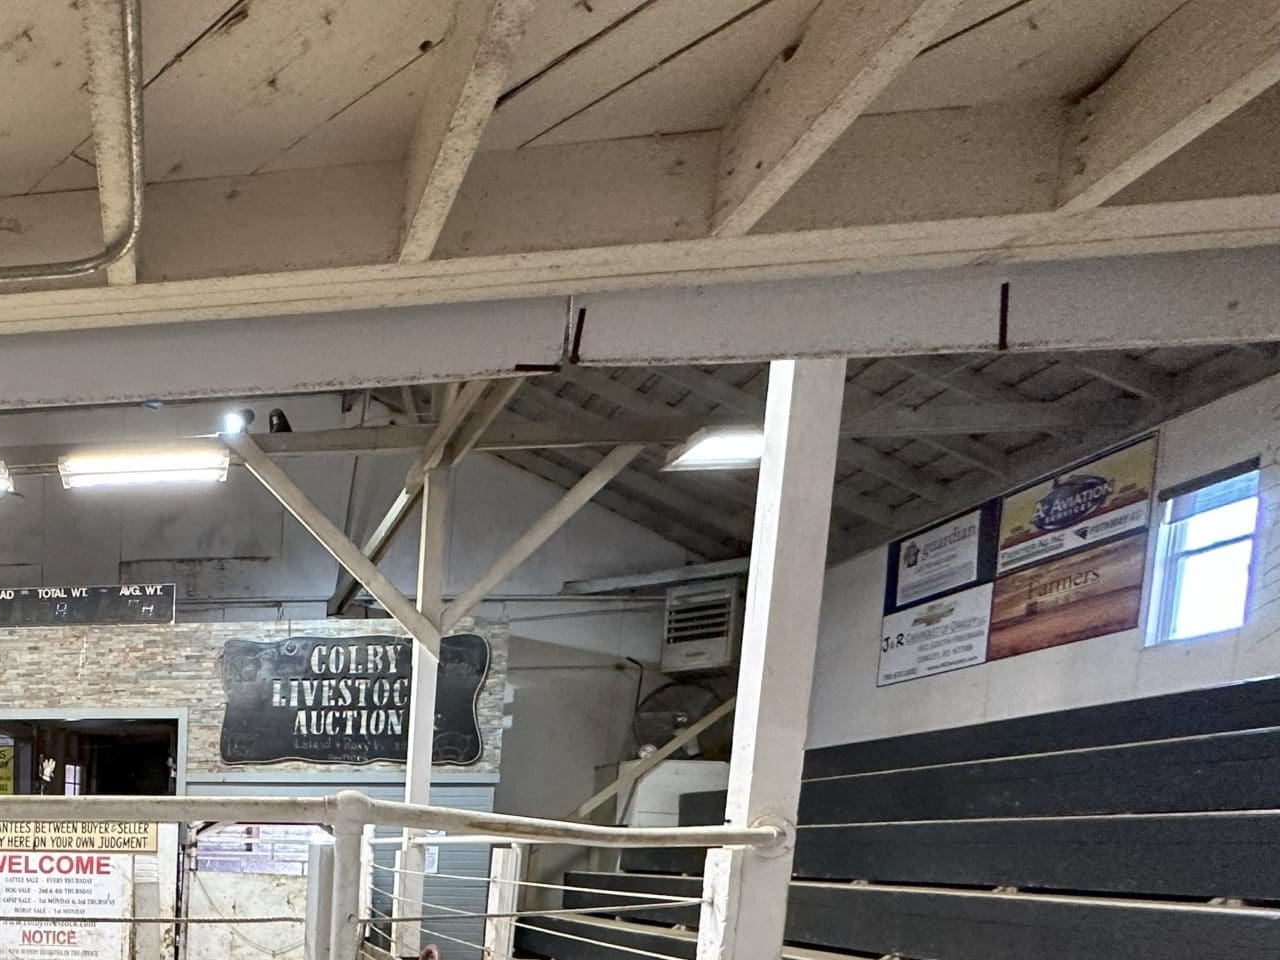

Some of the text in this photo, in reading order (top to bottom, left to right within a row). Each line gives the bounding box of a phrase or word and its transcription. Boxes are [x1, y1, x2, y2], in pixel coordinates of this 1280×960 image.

[1053, 483, 1112, 512] AVIATION
[37, 587, 89, 599] TOTAL WT.
[119, 585, 163, 596] AVG. WT.
[1027, 569, 1100, 600] Farmers
[310, 645, 402, 674] COLBY
[272, 678, 409, 707] LIVESTOC
[292, 708, 404, 736] AUCTION
[35, 821, 78, 834] BETWEEN
[81, 822, 110, 834] BUYER
[117, 822, 150, 835] SELLER
[7, 836, 31, 849] HERE
[35, 836, 47, 849] ON
[50, 836, 74, 849] YOUR
[75, 836, 95, 849] OWN
[98, 836, 148, 849] JUDGMENT
[21, 929, 77, 945] NOTICE
